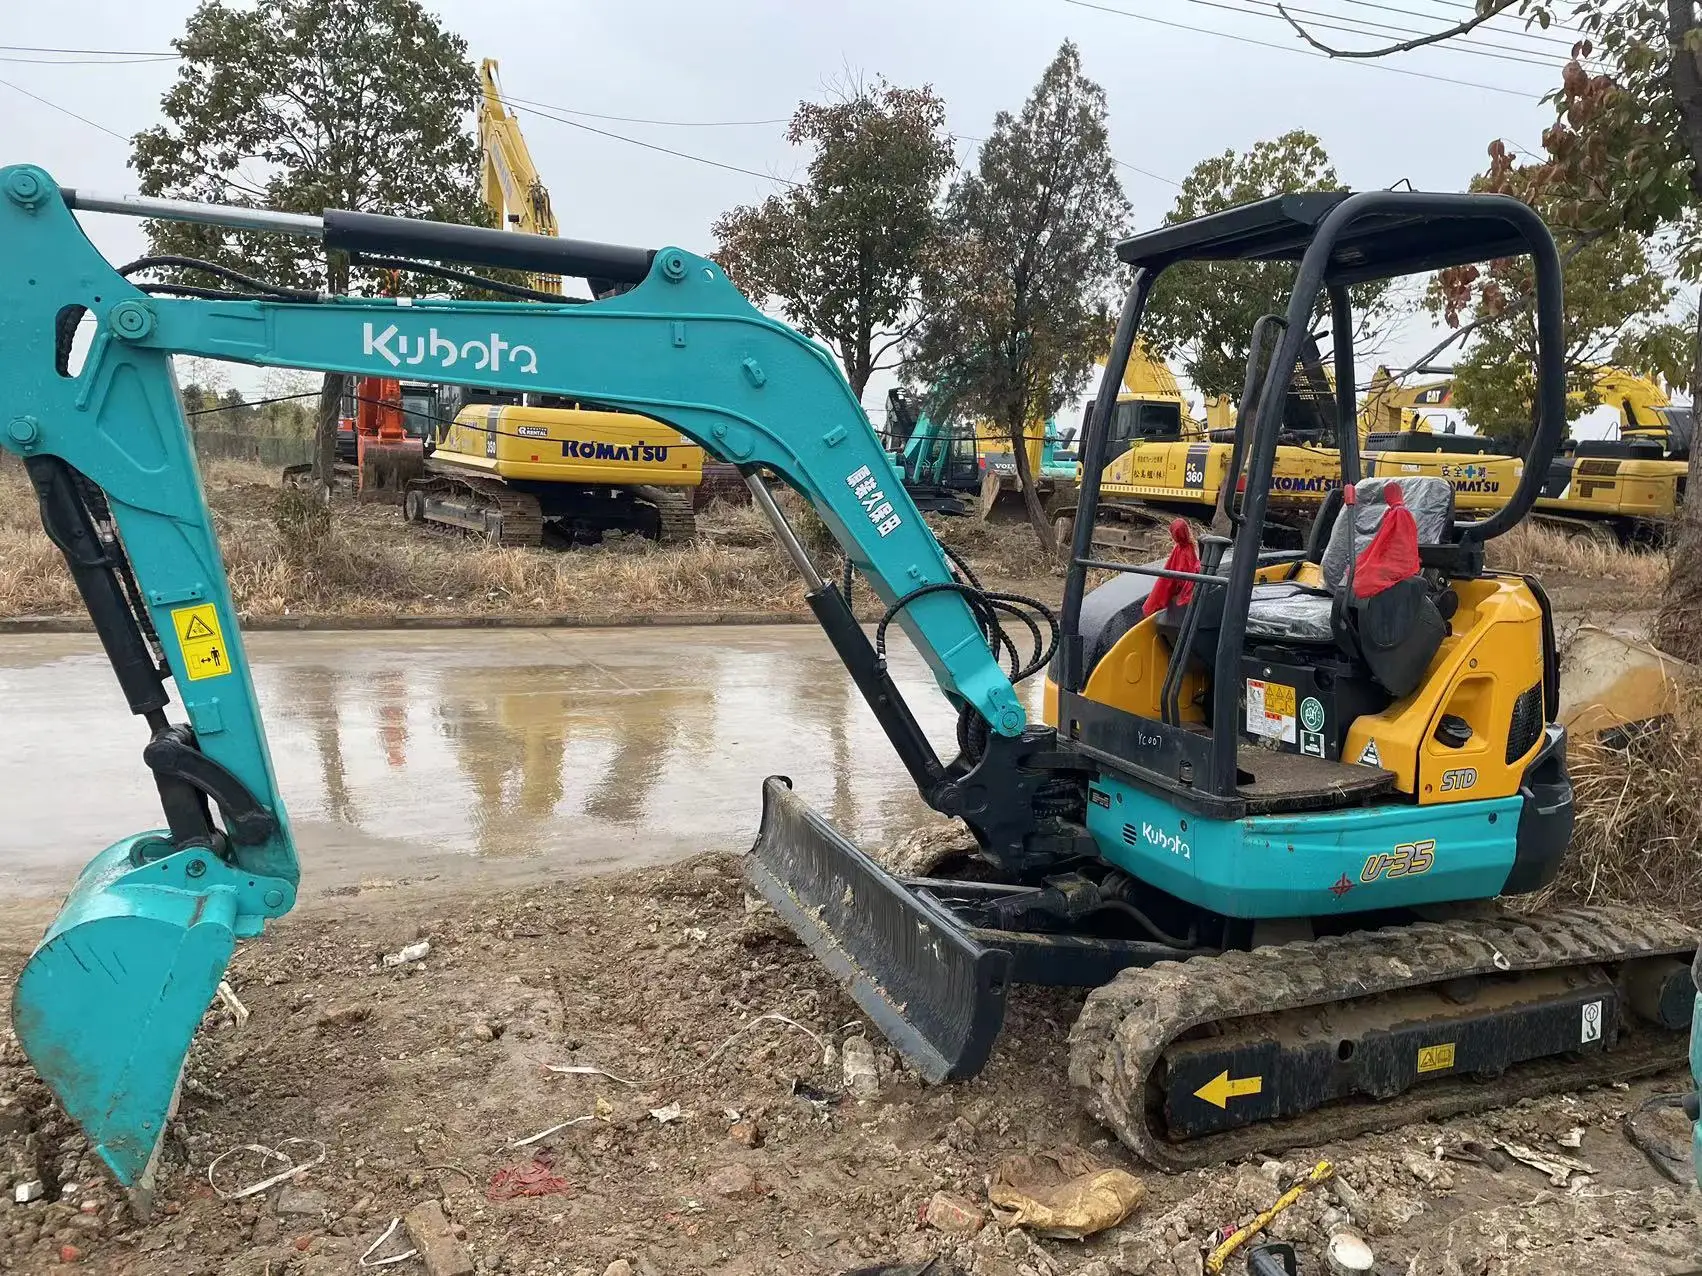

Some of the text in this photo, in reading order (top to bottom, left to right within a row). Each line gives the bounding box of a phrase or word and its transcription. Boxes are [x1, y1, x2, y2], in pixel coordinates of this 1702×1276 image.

[363, 322, 538, 374] Kubota
[1426, 390, 1441, 403] CAT
[562, 440, 668, 462] KOMATSU
[1186, 471, 1203, 483] 360
[1187, 463, 1196, 471] PC
[1441, 465, 1463, 477] 安全
[1440, 767, 1478, 792] STD
[1142, 821, 1190, 859] Kubota
[1360, 839, 1436, 882] U-35
